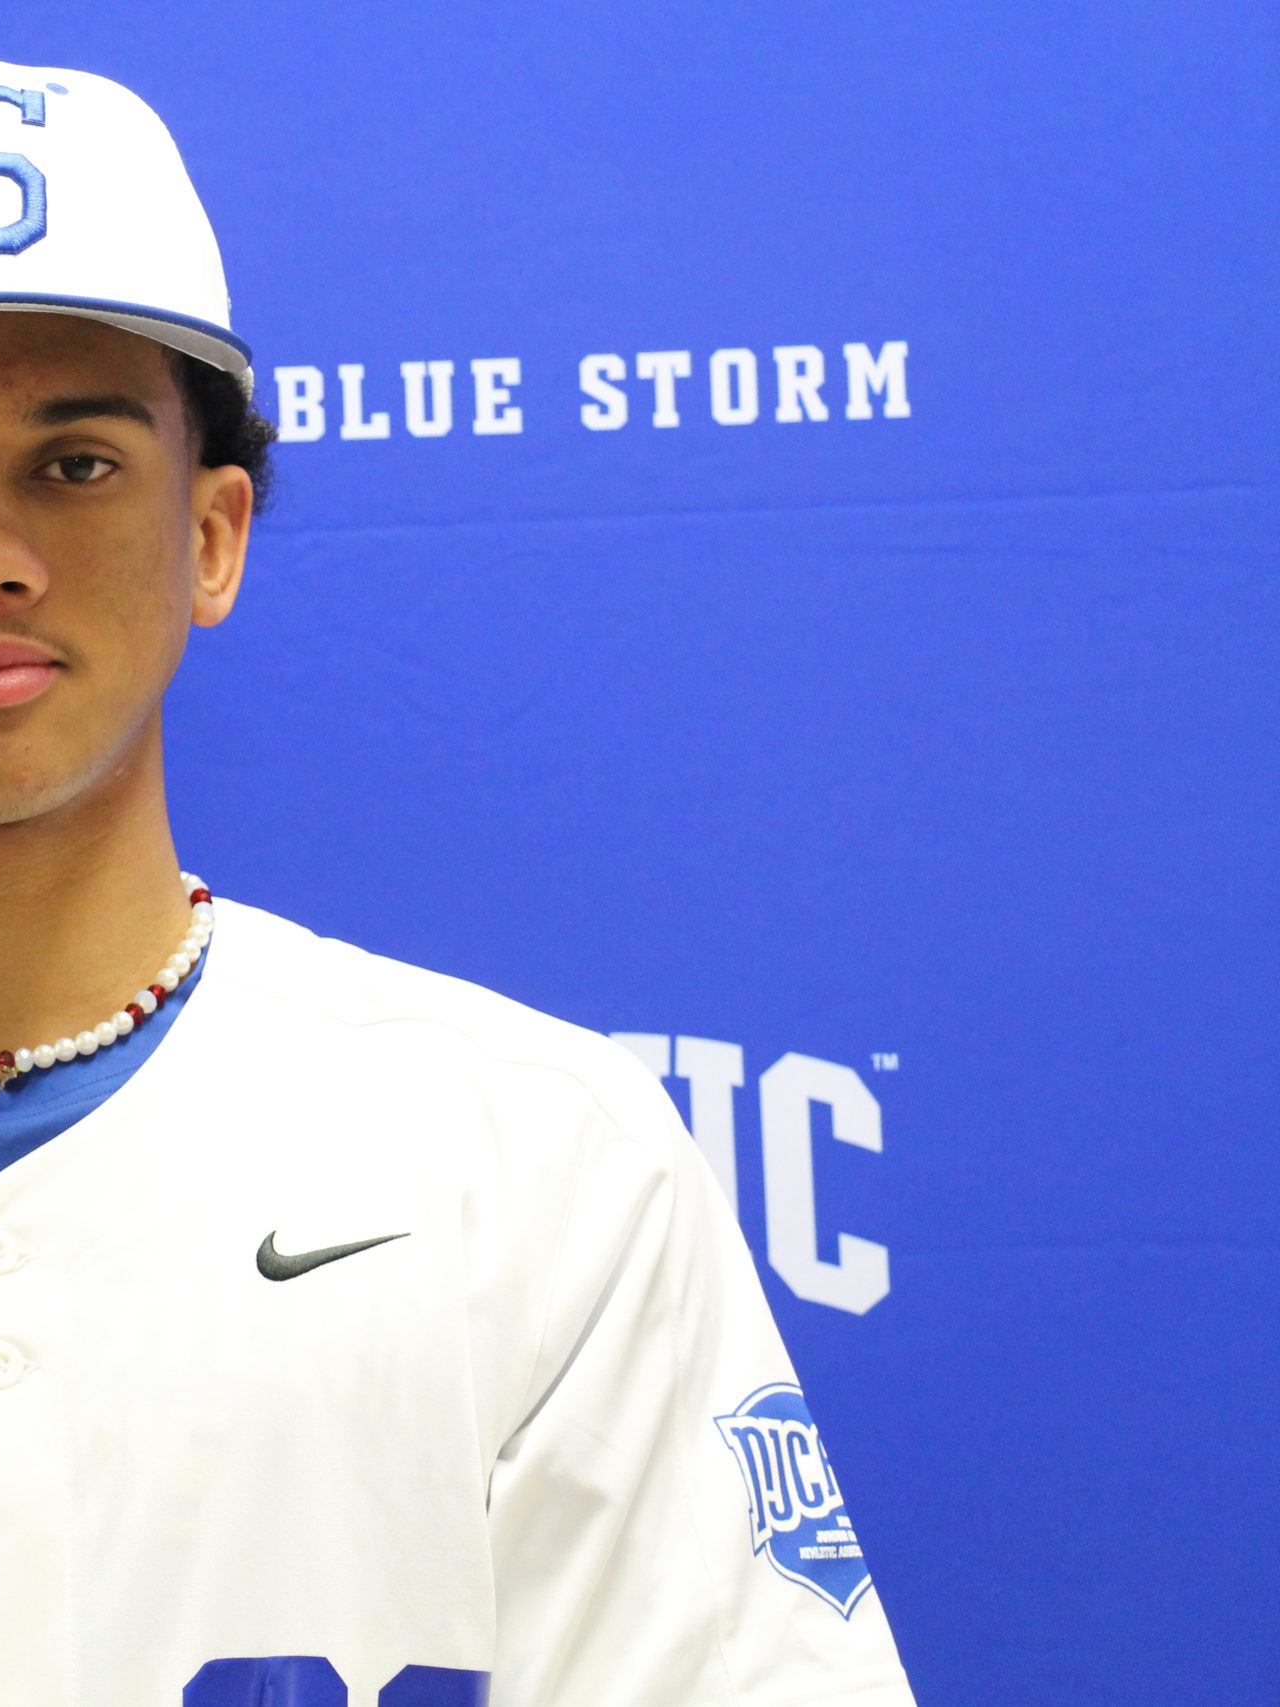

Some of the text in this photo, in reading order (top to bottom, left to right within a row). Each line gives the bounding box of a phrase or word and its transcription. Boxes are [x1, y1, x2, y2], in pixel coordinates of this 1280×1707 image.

[273, 341, 911, 443] BLUE STORM
[608, 1031, 891, 1317] IC
